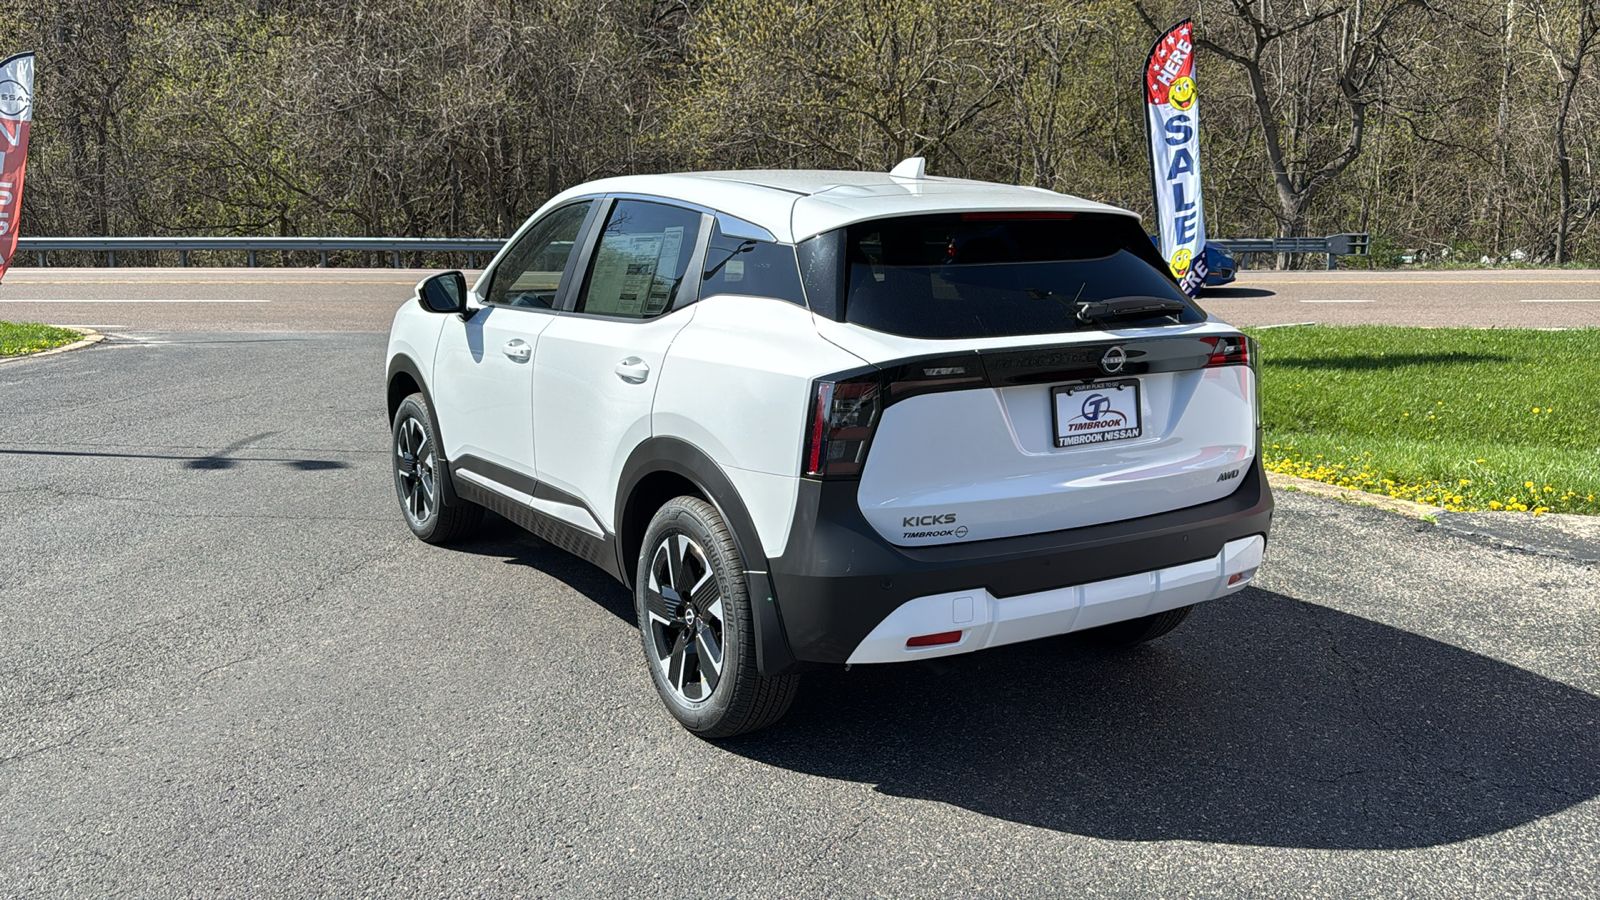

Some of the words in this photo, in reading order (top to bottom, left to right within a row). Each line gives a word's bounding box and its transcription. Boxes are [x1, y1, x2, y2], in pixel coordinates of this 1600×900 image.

[1157, 38, 1192, 87] HERE
[1, 93, 32, 103] SSAN
[1164, 115, 1196, 245] SALE
[1179, 260, 1209, 295] ERE
[1101, 356, 1126, 364] NISSAN
[1068, 418, 1122, 432] TIMBROOK
[1059, 432, 1103, 447] TIMBROOK
[1104, 428, 1139, 441] NISSAN
[1216, 469, 1239, 482] AWD
[902, 513, 957, 527] KICKS
[903, 530, 955, 538] TIMBROOK
[702, 533, 736, 635] BRIDGESTONE
